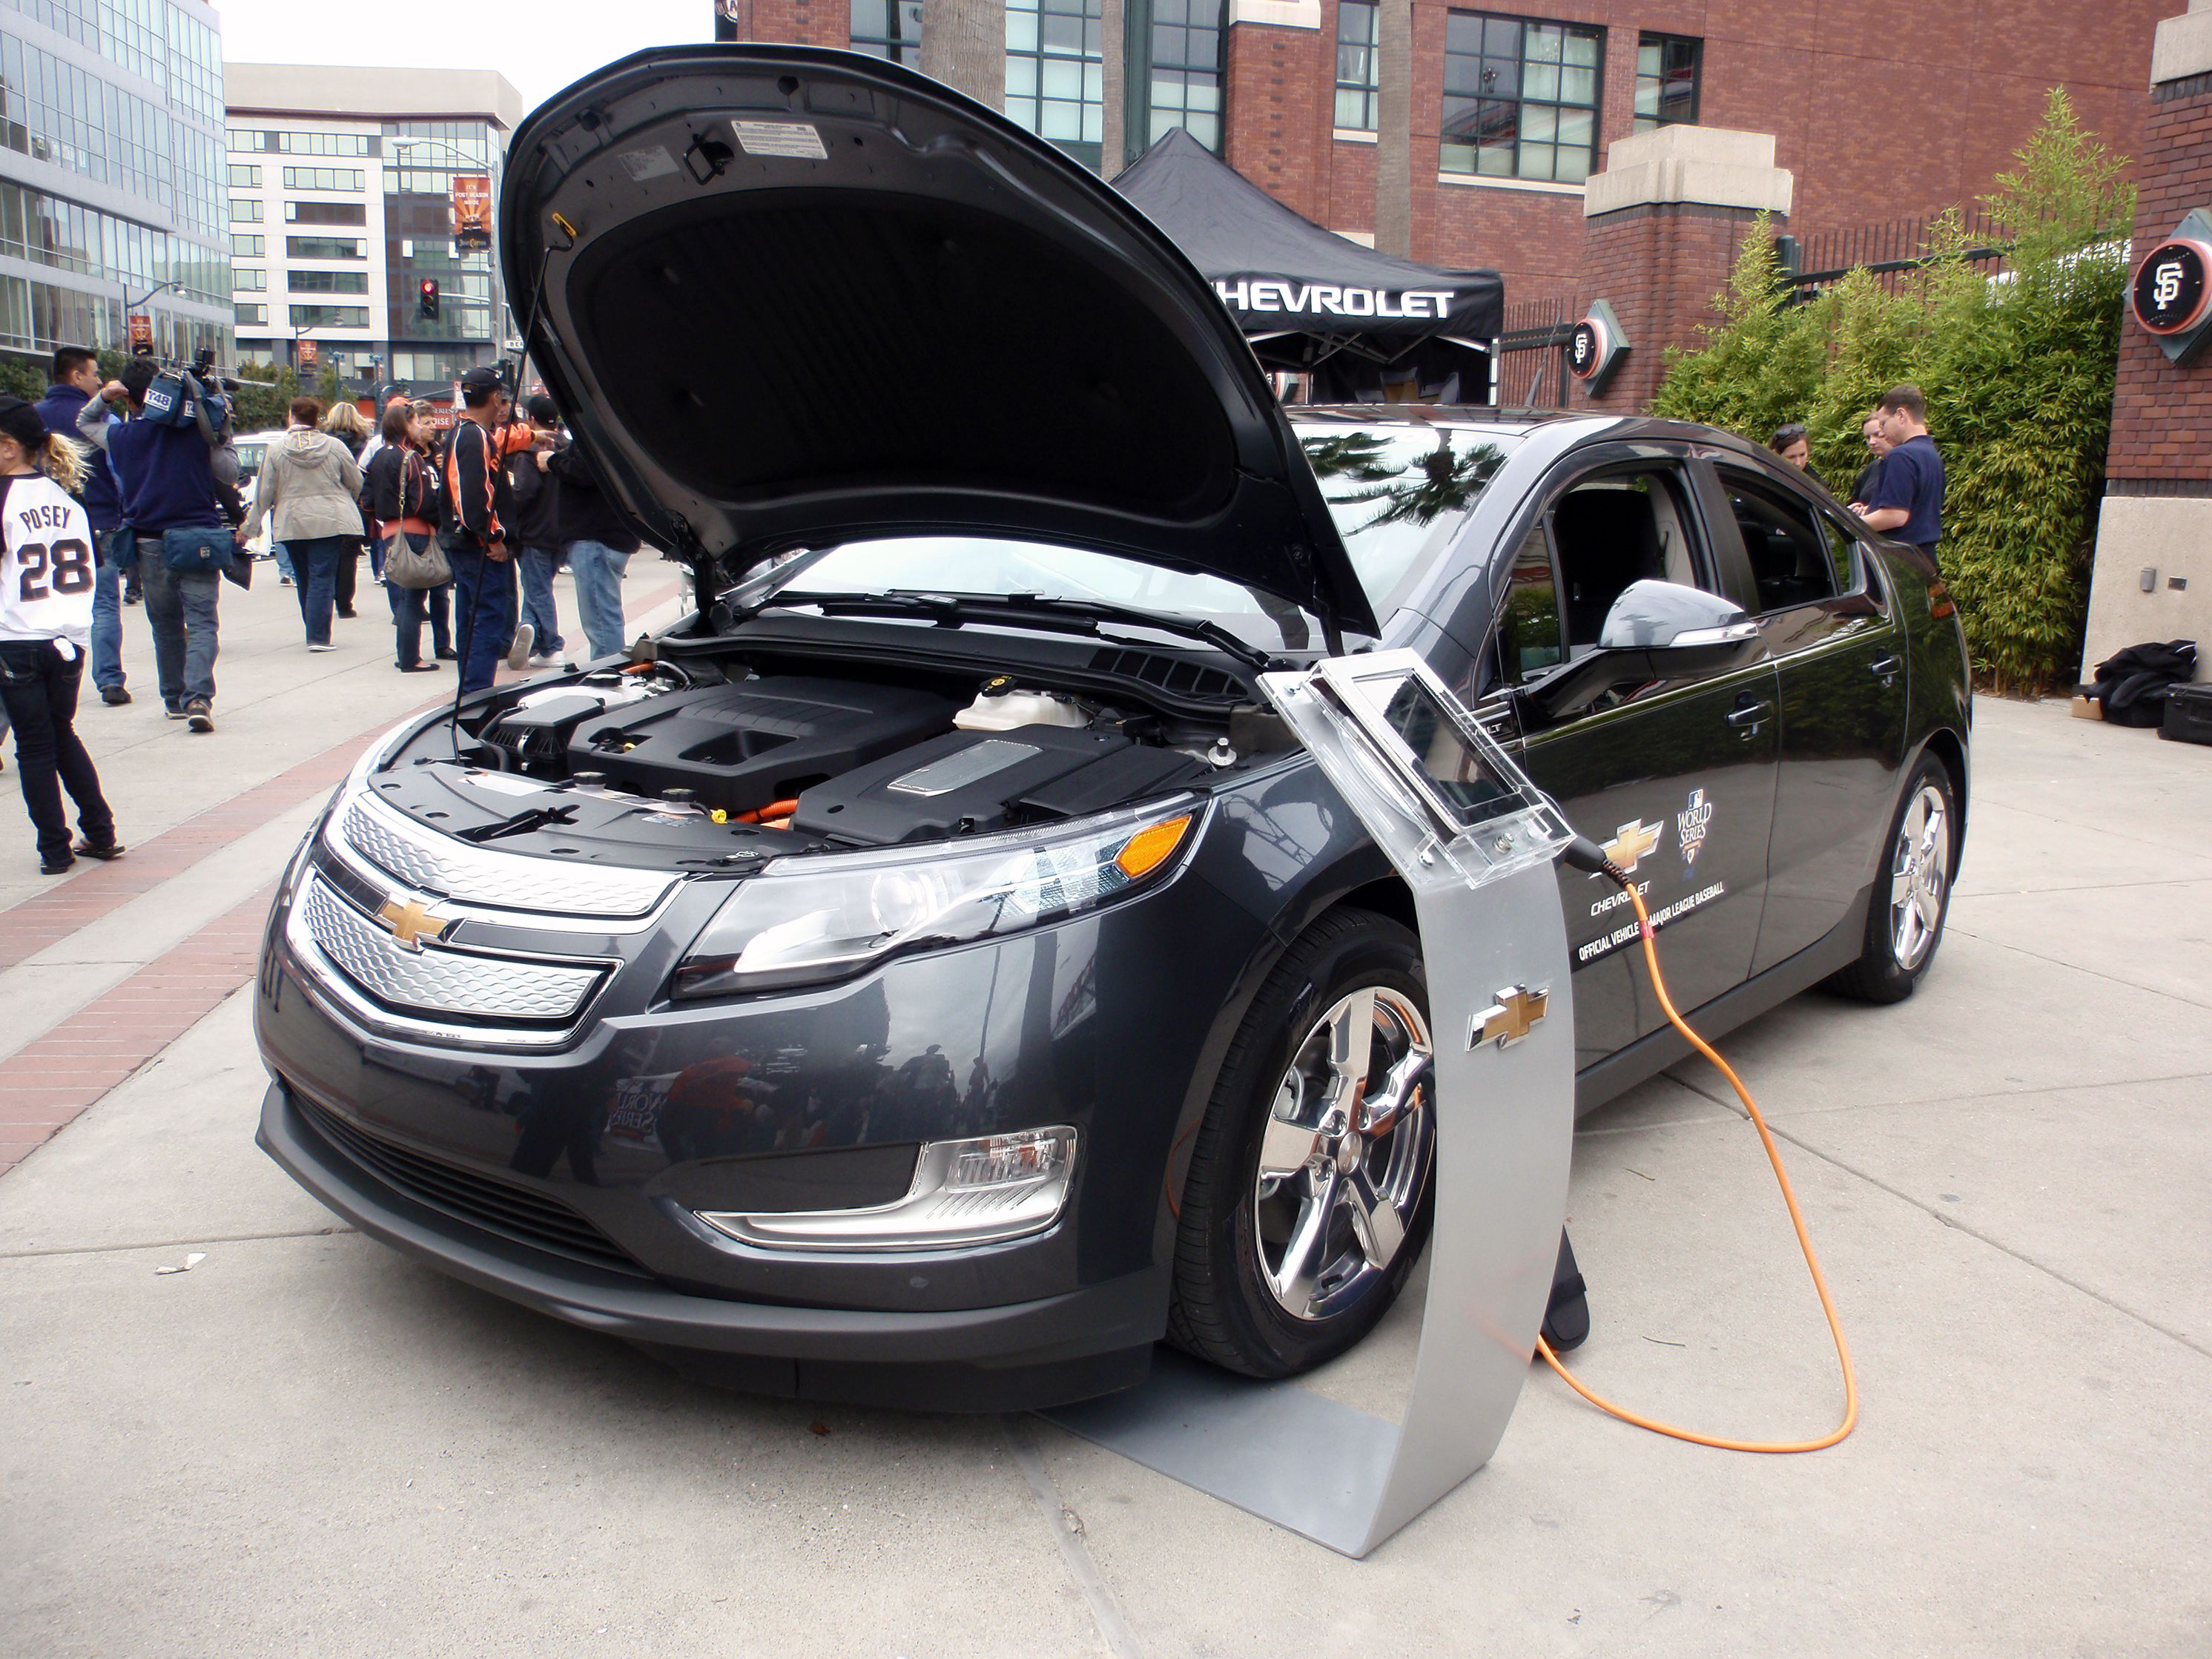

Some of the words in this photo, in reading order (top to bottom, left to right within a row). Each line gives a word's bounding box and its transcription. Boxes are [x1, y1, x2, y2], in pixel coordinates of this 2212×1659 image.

[1211, 281, 1454, 319] HEVROLET
[148, 390, 170, 407] T48
[19, 505, 71, 534] POSEY
[16, 538, 94, 603] 28
[1677, 802, 1712, 831] WORLD
[1679, 821, 1706, 847] SERIES
[1590, 880, 1651, 917] CHEVRET
[1578, 934, 1611, 961] OFFICIAL
[1611, 921, 1640, 946] VEHICLE
[1648, 906, 1672, 927] MAJOR
[1671, 894, 1696, 917] LEAGUE
[1694, 881, 1725, 905] BASEBALL
